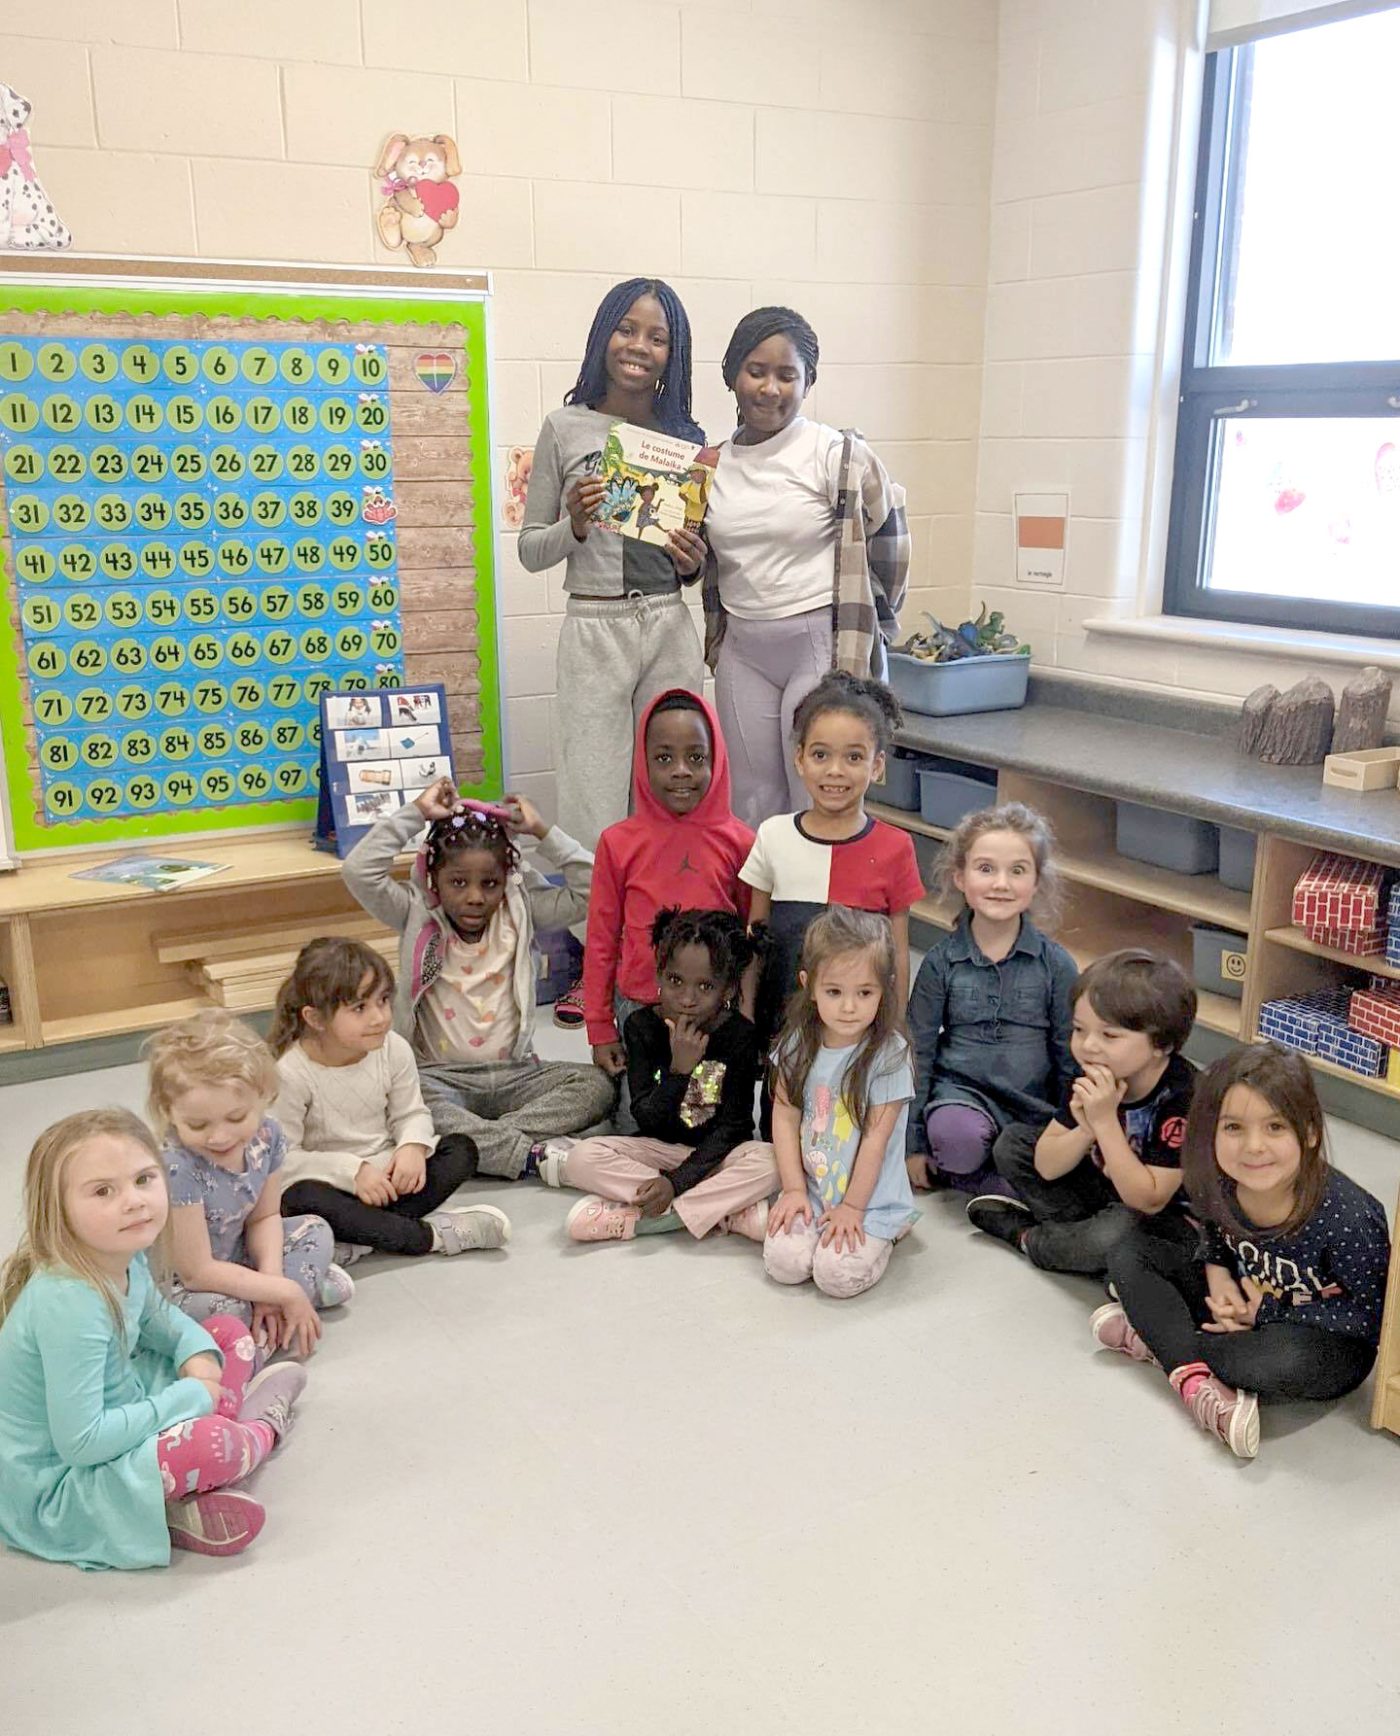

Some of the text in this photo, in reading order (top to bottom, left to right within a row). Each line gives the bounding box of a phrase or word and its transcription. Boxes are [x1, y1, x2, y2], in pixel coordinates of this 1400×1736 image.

[11, 353, 380, 377] 1 2 3 4 5 6 7 8 9 10
[11, 403, 384, 425] 11 12 13 14 15 16 17 18 19 20
[14, 454, 386, 474] 21 22 23 24 25 26 27 28 29 30
[639, 451, 650, 461] de
[641, 440, 651, 450] Le
[652, 445, 685, 461] costume
[19, 500, 353, 524] 31 32 33 34 35 36 37 38 39
[25, 544, 392, 574] 41 42 43 44 45 46 47 48 49 50
[33, 589, 394, 624] 51 52 53 54 55 56 57 58 59 60
[37, 633, 397, 670] 61 62 63 64 65 66 67 68 69 70
[42, 699, 62, 717] 71
[82, 696, 108, 714] 72
[122, 693, 146, 711] 73
[160, 691, 185, 708] 74
[199, 688, 222, 706] 75
[237, 685, 259, 703] 76
[273, 683, 296, 701] 77
[50, 745, 68, 763] 81
[88, 742, 112, 760] 82
[128, 738, 150, 757] 83
[165, 735, 189, 753] 84
[204, 732, 226, 750] 85
[241, 729, 263, 747] 86
[277, 726, 298, 744] 87
[54, 790, 73, 807] 91
[91, 787, 117, 804] 92
[131, 783, 155, 801] 93
[168, 779, 192, 797] 94
[207, 776, 229, 793] 95
[243, 772, 266, 790] 96
[280, 769, 302, 786] 97
